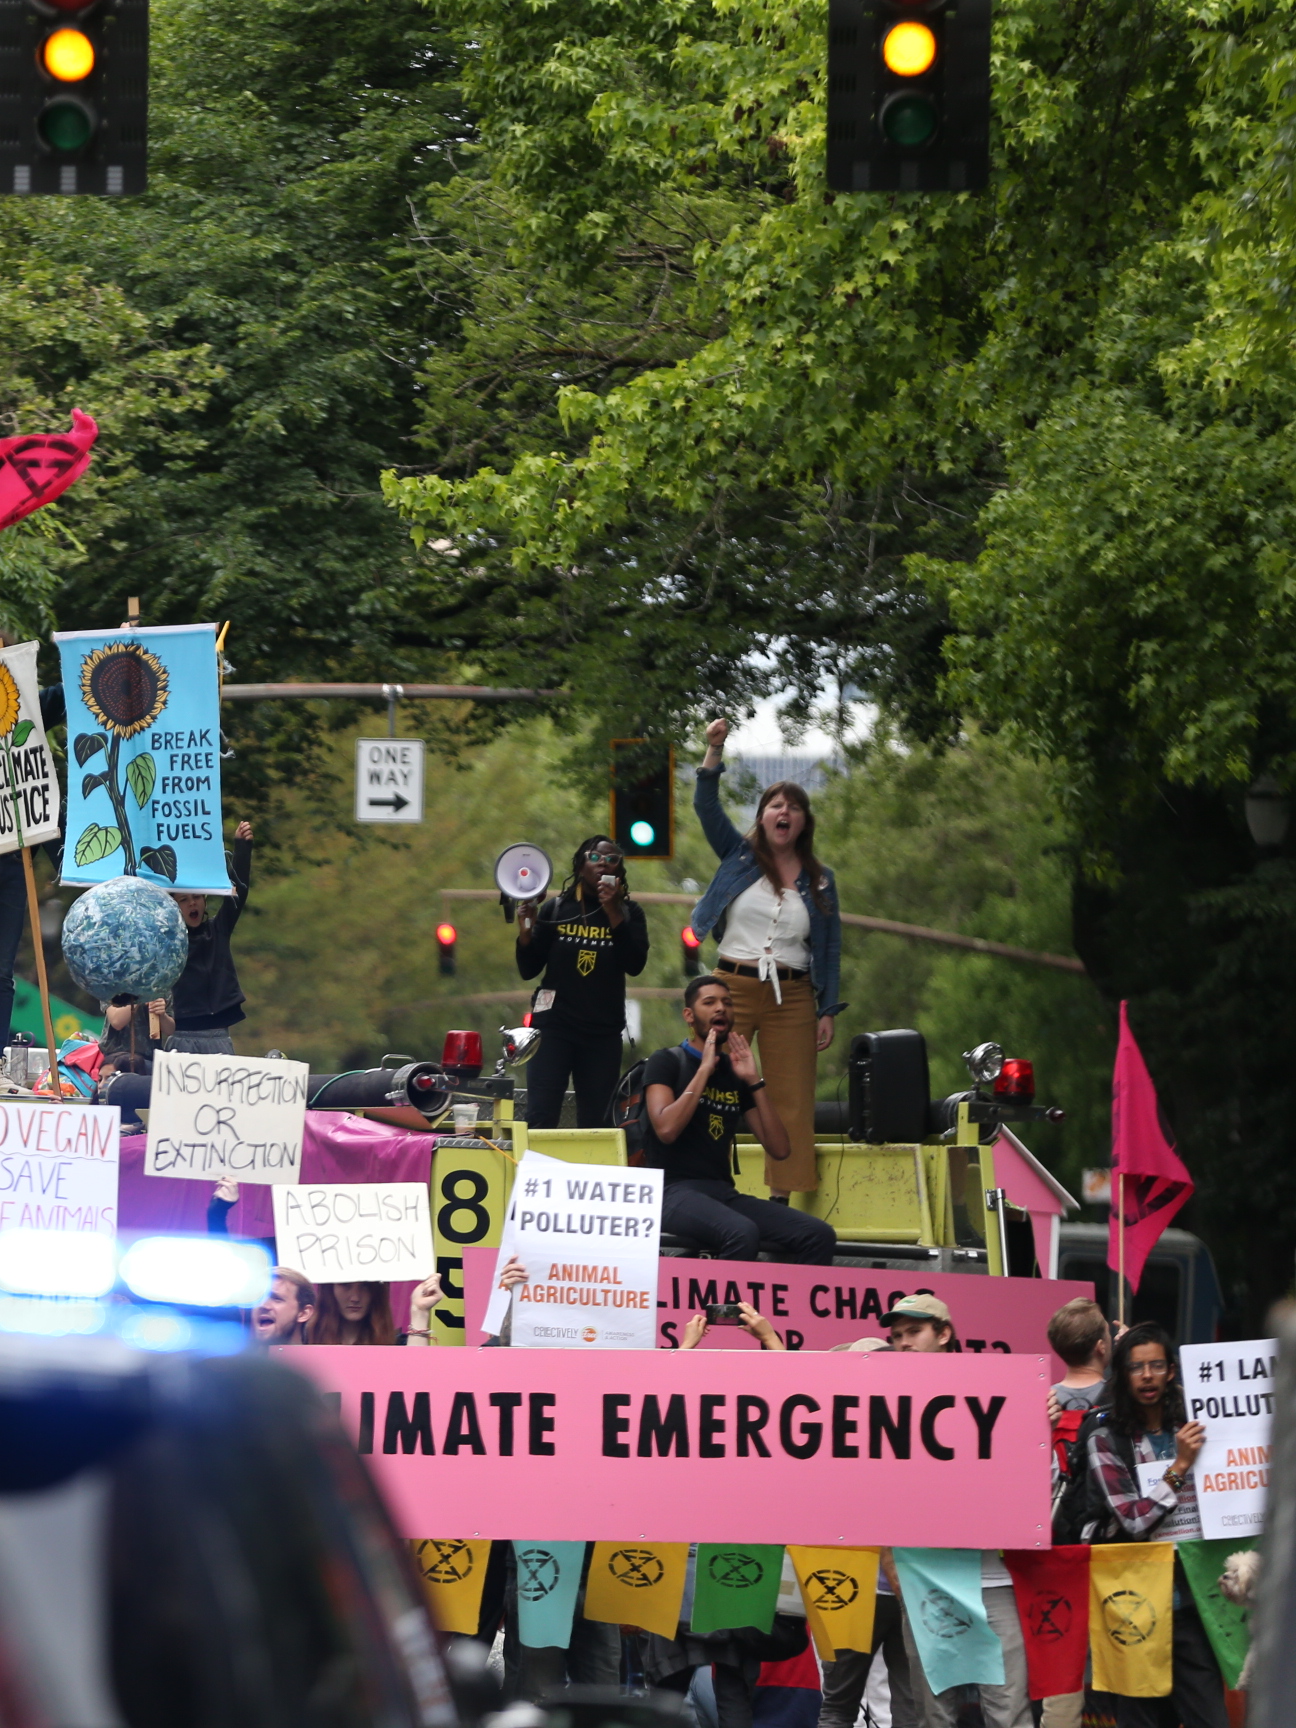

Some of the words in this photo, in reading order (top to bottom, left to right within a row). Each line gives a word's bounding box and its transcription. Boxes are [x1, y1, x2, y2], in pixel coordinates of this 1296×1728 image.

[151, 729, 213, 750] BREAK
[170, 752, 214, 771] FREE
[369, 746, 411, 764] ONE
[162, 775, 211, 794] FROM
[367, 768, 412, 786] WAY
[152, 799, 211, 818] FOSSIL
[156, 822, 212, 841] FUELS
[157, 1060, 307, 1106] INSURRECTION
[16, 1108, 114, 1158] VEGAN
[194, 1104, 241, 1141] OR
[154, 1138, 299, 1172] EXTINCTION
[524, 1178, 553, 1199] #1
[566, 1180, 654, 1205] WATER
[286, 1190, 420, 1226] ABOLISH
[437, 1170, 491, 1244] 8
[520, 1210, 655, 1238] POLLUTER?
[296, 1232, 417, 1270] PRISON
[548, 1263, 623, 1285] ANIMAL
[519, 1284, 651, 1309] AGRICULTURE
[1198, 1359, 1225, 1383] #1
[602, 1393, 1007, 1460] EMERGENCY
